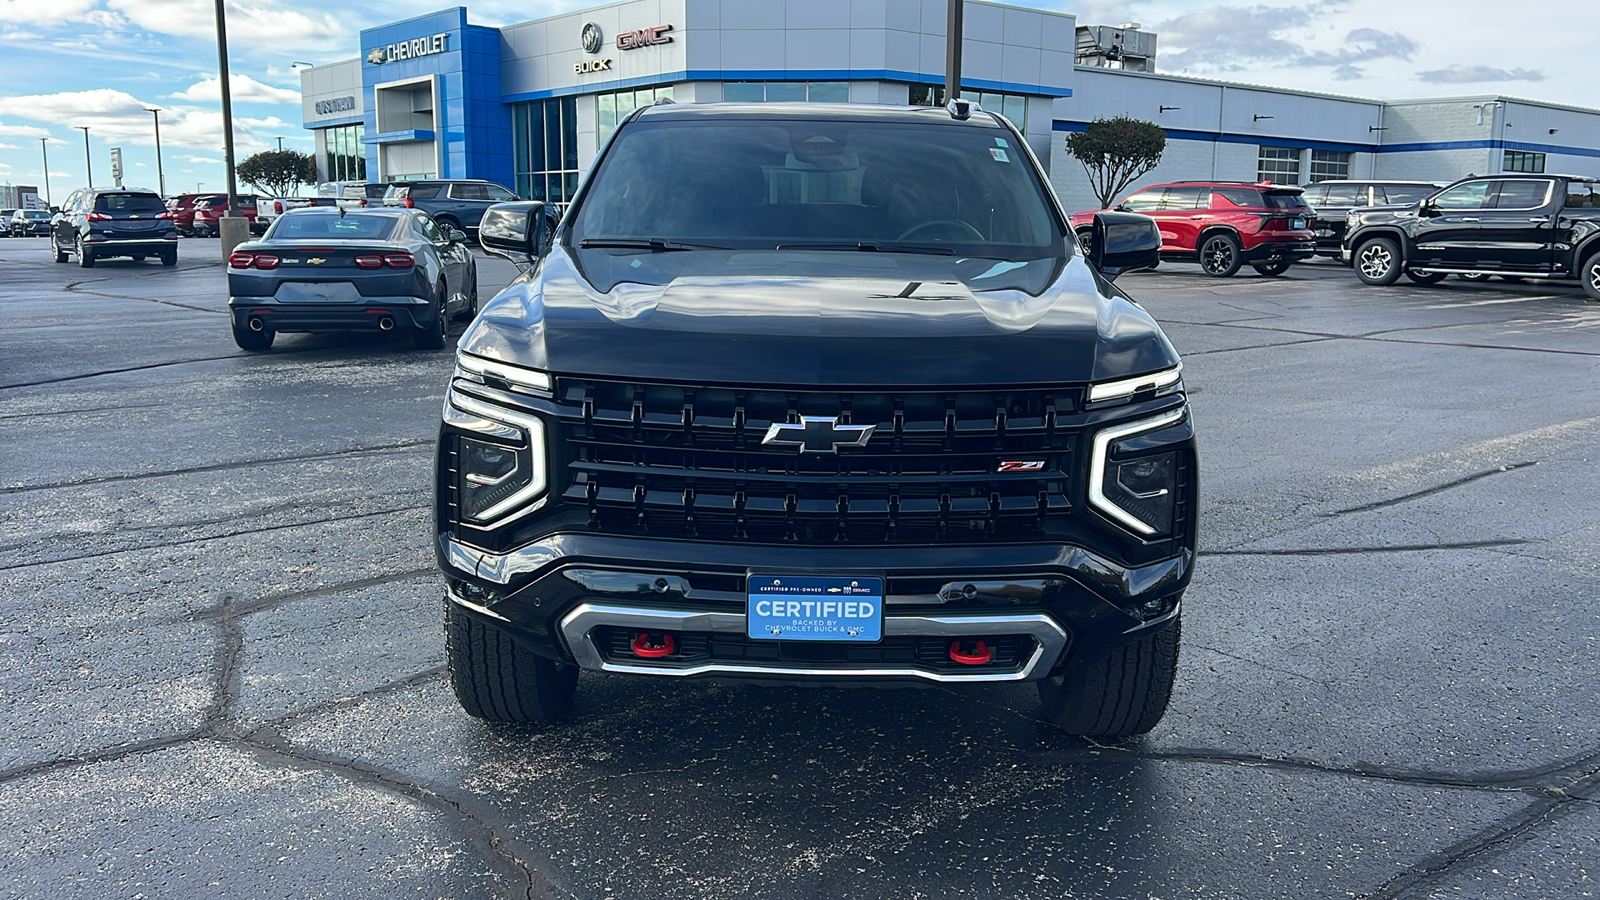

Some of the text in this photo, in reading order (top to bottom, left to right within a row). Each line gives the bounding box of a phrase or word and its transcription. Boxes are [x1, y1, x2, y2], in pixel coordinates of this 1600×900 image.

[616, 24, 673, 50] GMC
[387, 32, 449, 61] CHEVROLET
[573, 58, 611, 74] BUICK
[756, 600, 875, 618] CERTIFIED
[764, 624, 811, 632] CHEVROLET
